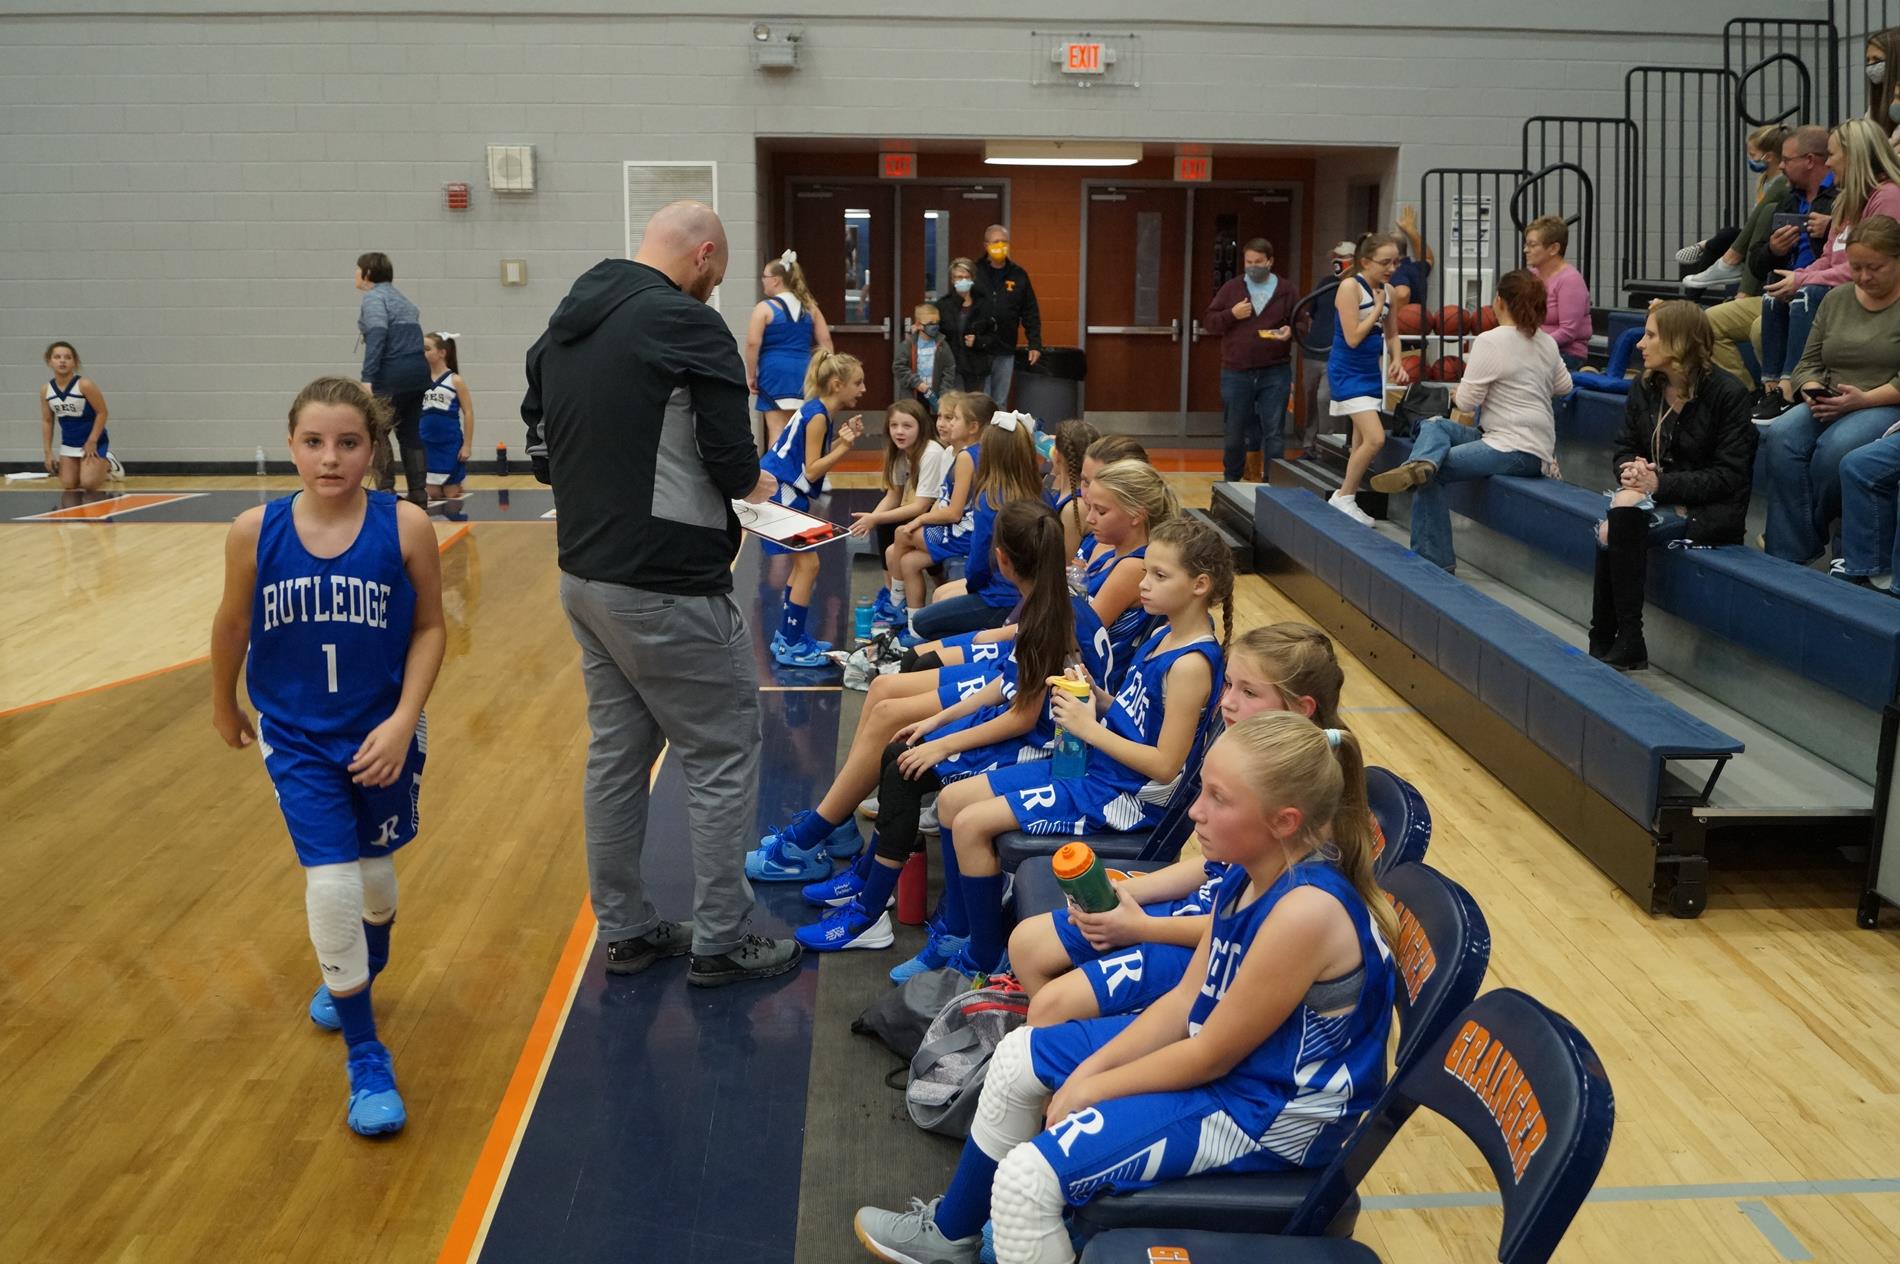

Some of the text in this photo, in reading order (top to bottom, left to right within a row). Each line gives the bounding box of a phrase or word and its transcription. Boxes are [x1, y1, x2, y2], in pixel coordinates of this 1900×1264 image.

[1069, 45, 1099, 68] EXIT
[1005, 280, 1016, 291] T
[262, 575, 391, 631] RUTLEDGE
[321, 643, 338, 693] 1
[971, 642, 999, 664] R
[957, 675, 986, 701] R
[1019, 783, 1056, 811] R
[370, 814, 399, 848] R
[1098, 949, 1144, 997] R
[1444, 1019, 1547, 1186] GRAINGER
[1048, 1106, 1105, 1158] R
